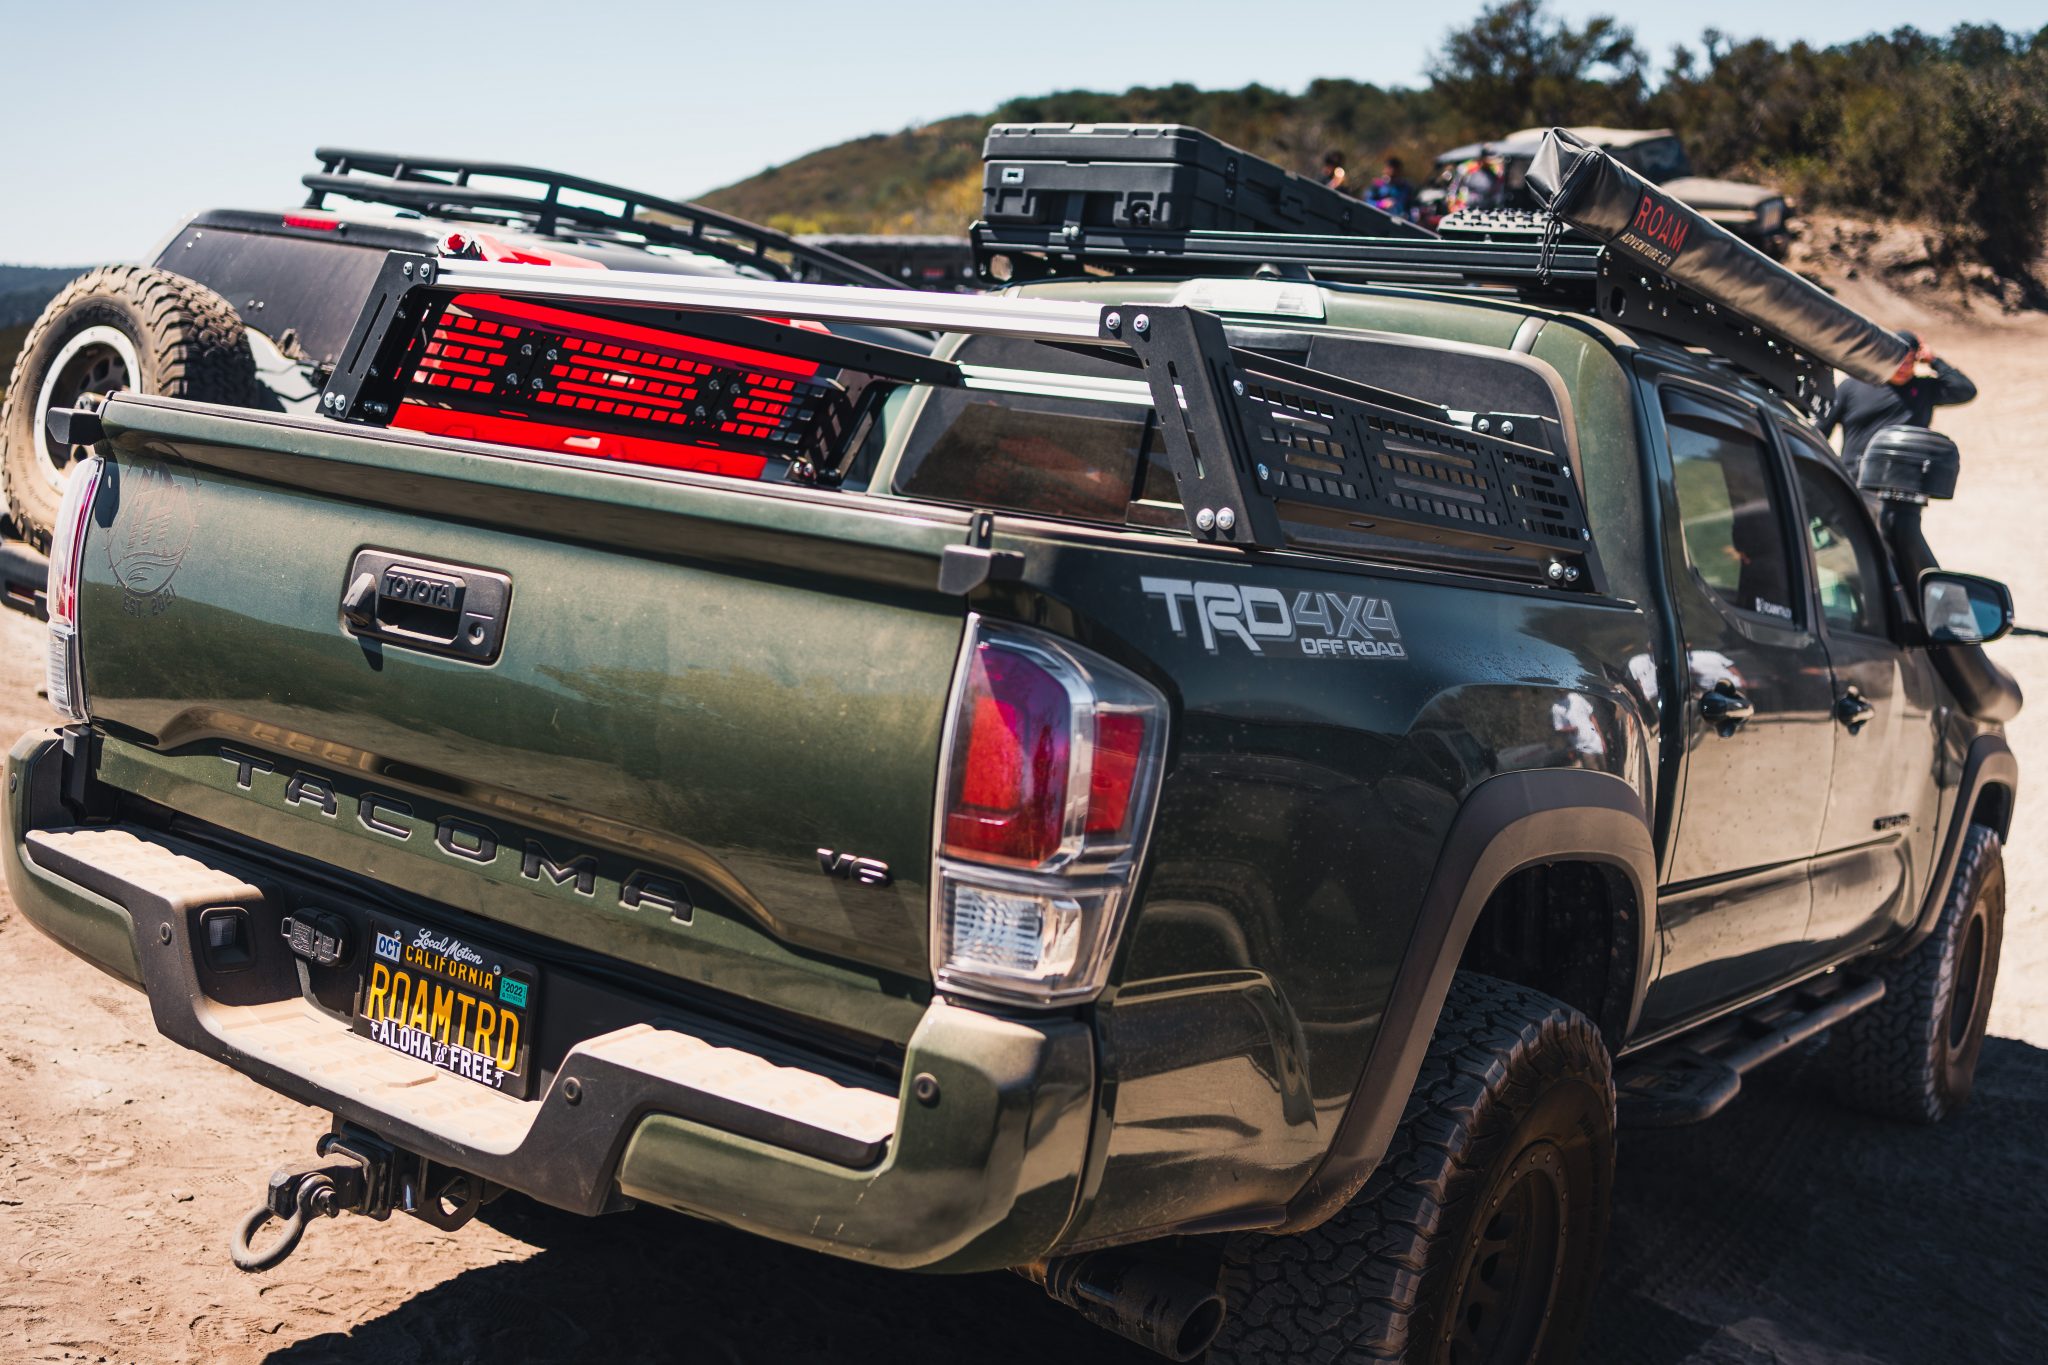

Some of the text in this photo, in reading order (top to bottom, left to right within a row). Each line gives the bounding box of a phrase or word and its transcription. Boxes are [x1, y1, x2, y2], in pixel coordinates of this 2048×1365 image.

[1634, 195, 1689, 253] ROAM
[1619, 232, 1662, 261] ADVENTURE
[386, 573, 452, 608] TOYOTA
[1140, 576, 1296, 656] TRD
[1300, 637, 1407, 659] OFF ROAD
[219, 745, 695, 927] TACOMA
[816, 847, 894, 888] V6
[378, 935, 401, 958] OCT
[412, 927, 483, 965] Local Motion
[405, 945, 494, 990] CALIFORNIA
[505, 982, 523, 997] 2022
[367, 962, 520, 1072] ROAMTRD
[379, 1020, 495, 1086] ALOHA is FREE
